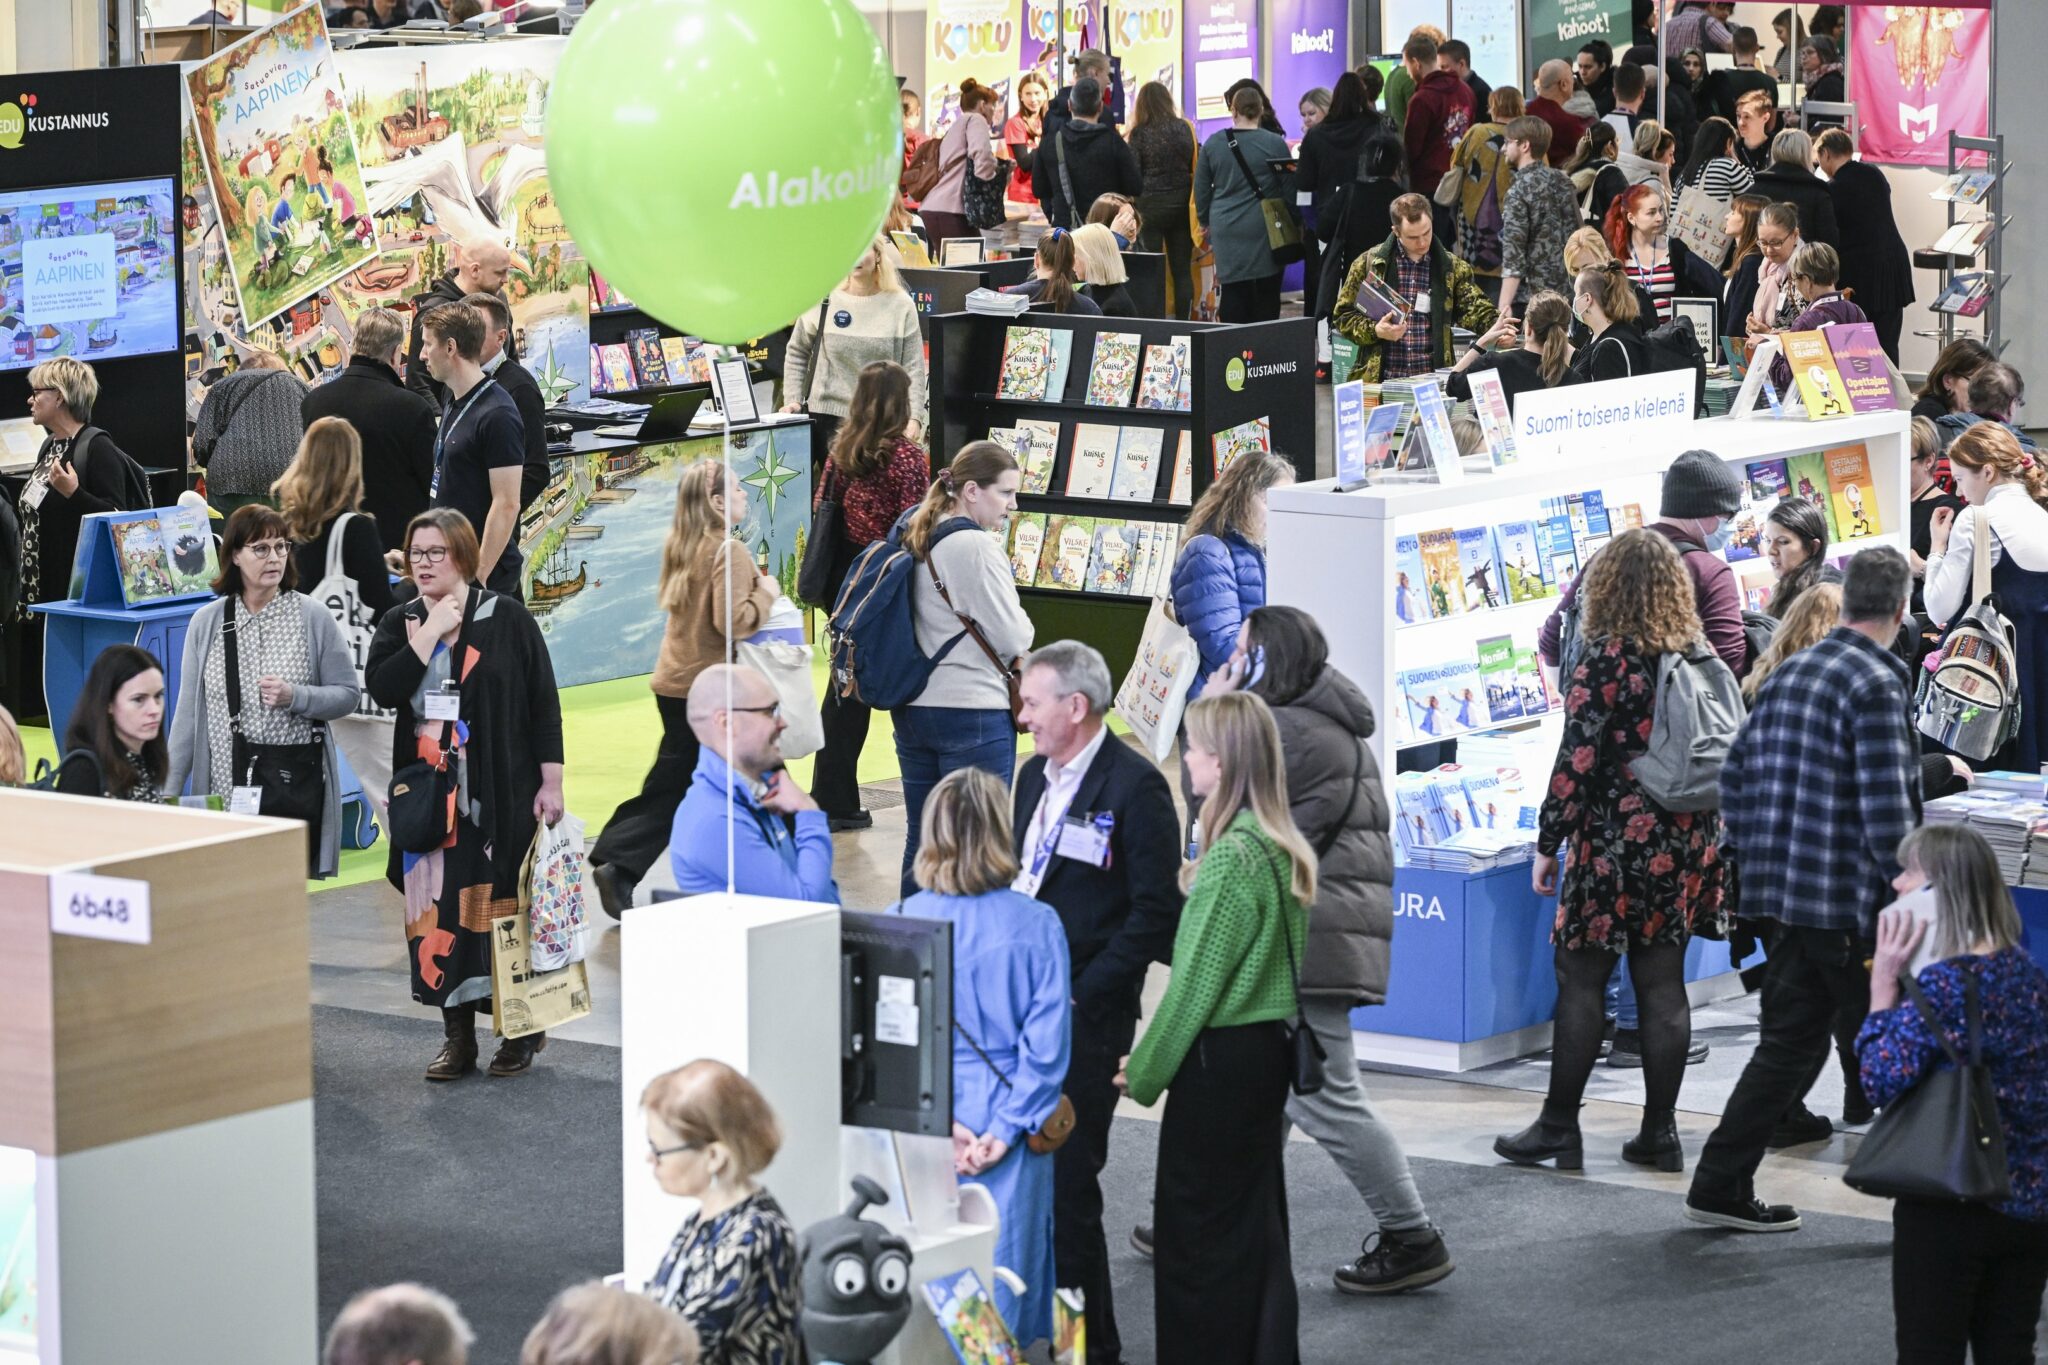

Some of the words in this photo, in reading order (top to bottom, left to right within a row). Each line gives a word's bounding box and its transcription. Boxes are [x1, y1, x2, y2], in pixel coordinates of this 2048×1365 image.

[1115, 8, 1174, 47] KOULU
[1558, 12, 1610, 41] Kahoot!
[934, 20, 1012, 60] KOULU
[1291, 28, 1334, 54] Kahoot!
[235, 64, 311, 124] AAPINEN
[28, 112, 109, 132] KUSTANNUS
[35, 262, 105, 285] AAPINEN
[1014, 355, 1038, 363] Kuiske
[1030, 363, 1037, 372] 3
[1101, 362, 1125, 371] Kuiske
[1152, 365, 1173, 373] Kuiske
[1228, 370, 1243, 381] EDU
[1247, 361, 1297, 378] KUSTANNUS
[1116, 372, 1123, 380] 4
[1166, 374, 1171, 384] 5
[1526, 408, 1574, 436] Suomi
[1577, 405, 1630, 428] toisena
[1634, 392, 1685, 420] kielenä
[1030, 440, 1053, 449] Kuiske
[1083, 449, 1105, 459] Kuiske
[1126, 453, 1149, 462] Kuiske
[1097, 459, 1104, 468] 3
[1141, 462, 1147, 471] 4
[1019, 533, 1040, 543] VILSKE
[1064, 537, 1089, 548] VILSKE
[1105, 541, 1123, 549] VILSKE
[1444, 664, 1474, 678] SUOMEN
[1408, 670, 1441, 685] SUOMEN
[69, 892, 129, 923] 6b48
[1393, 892, 1445, 921] URA
